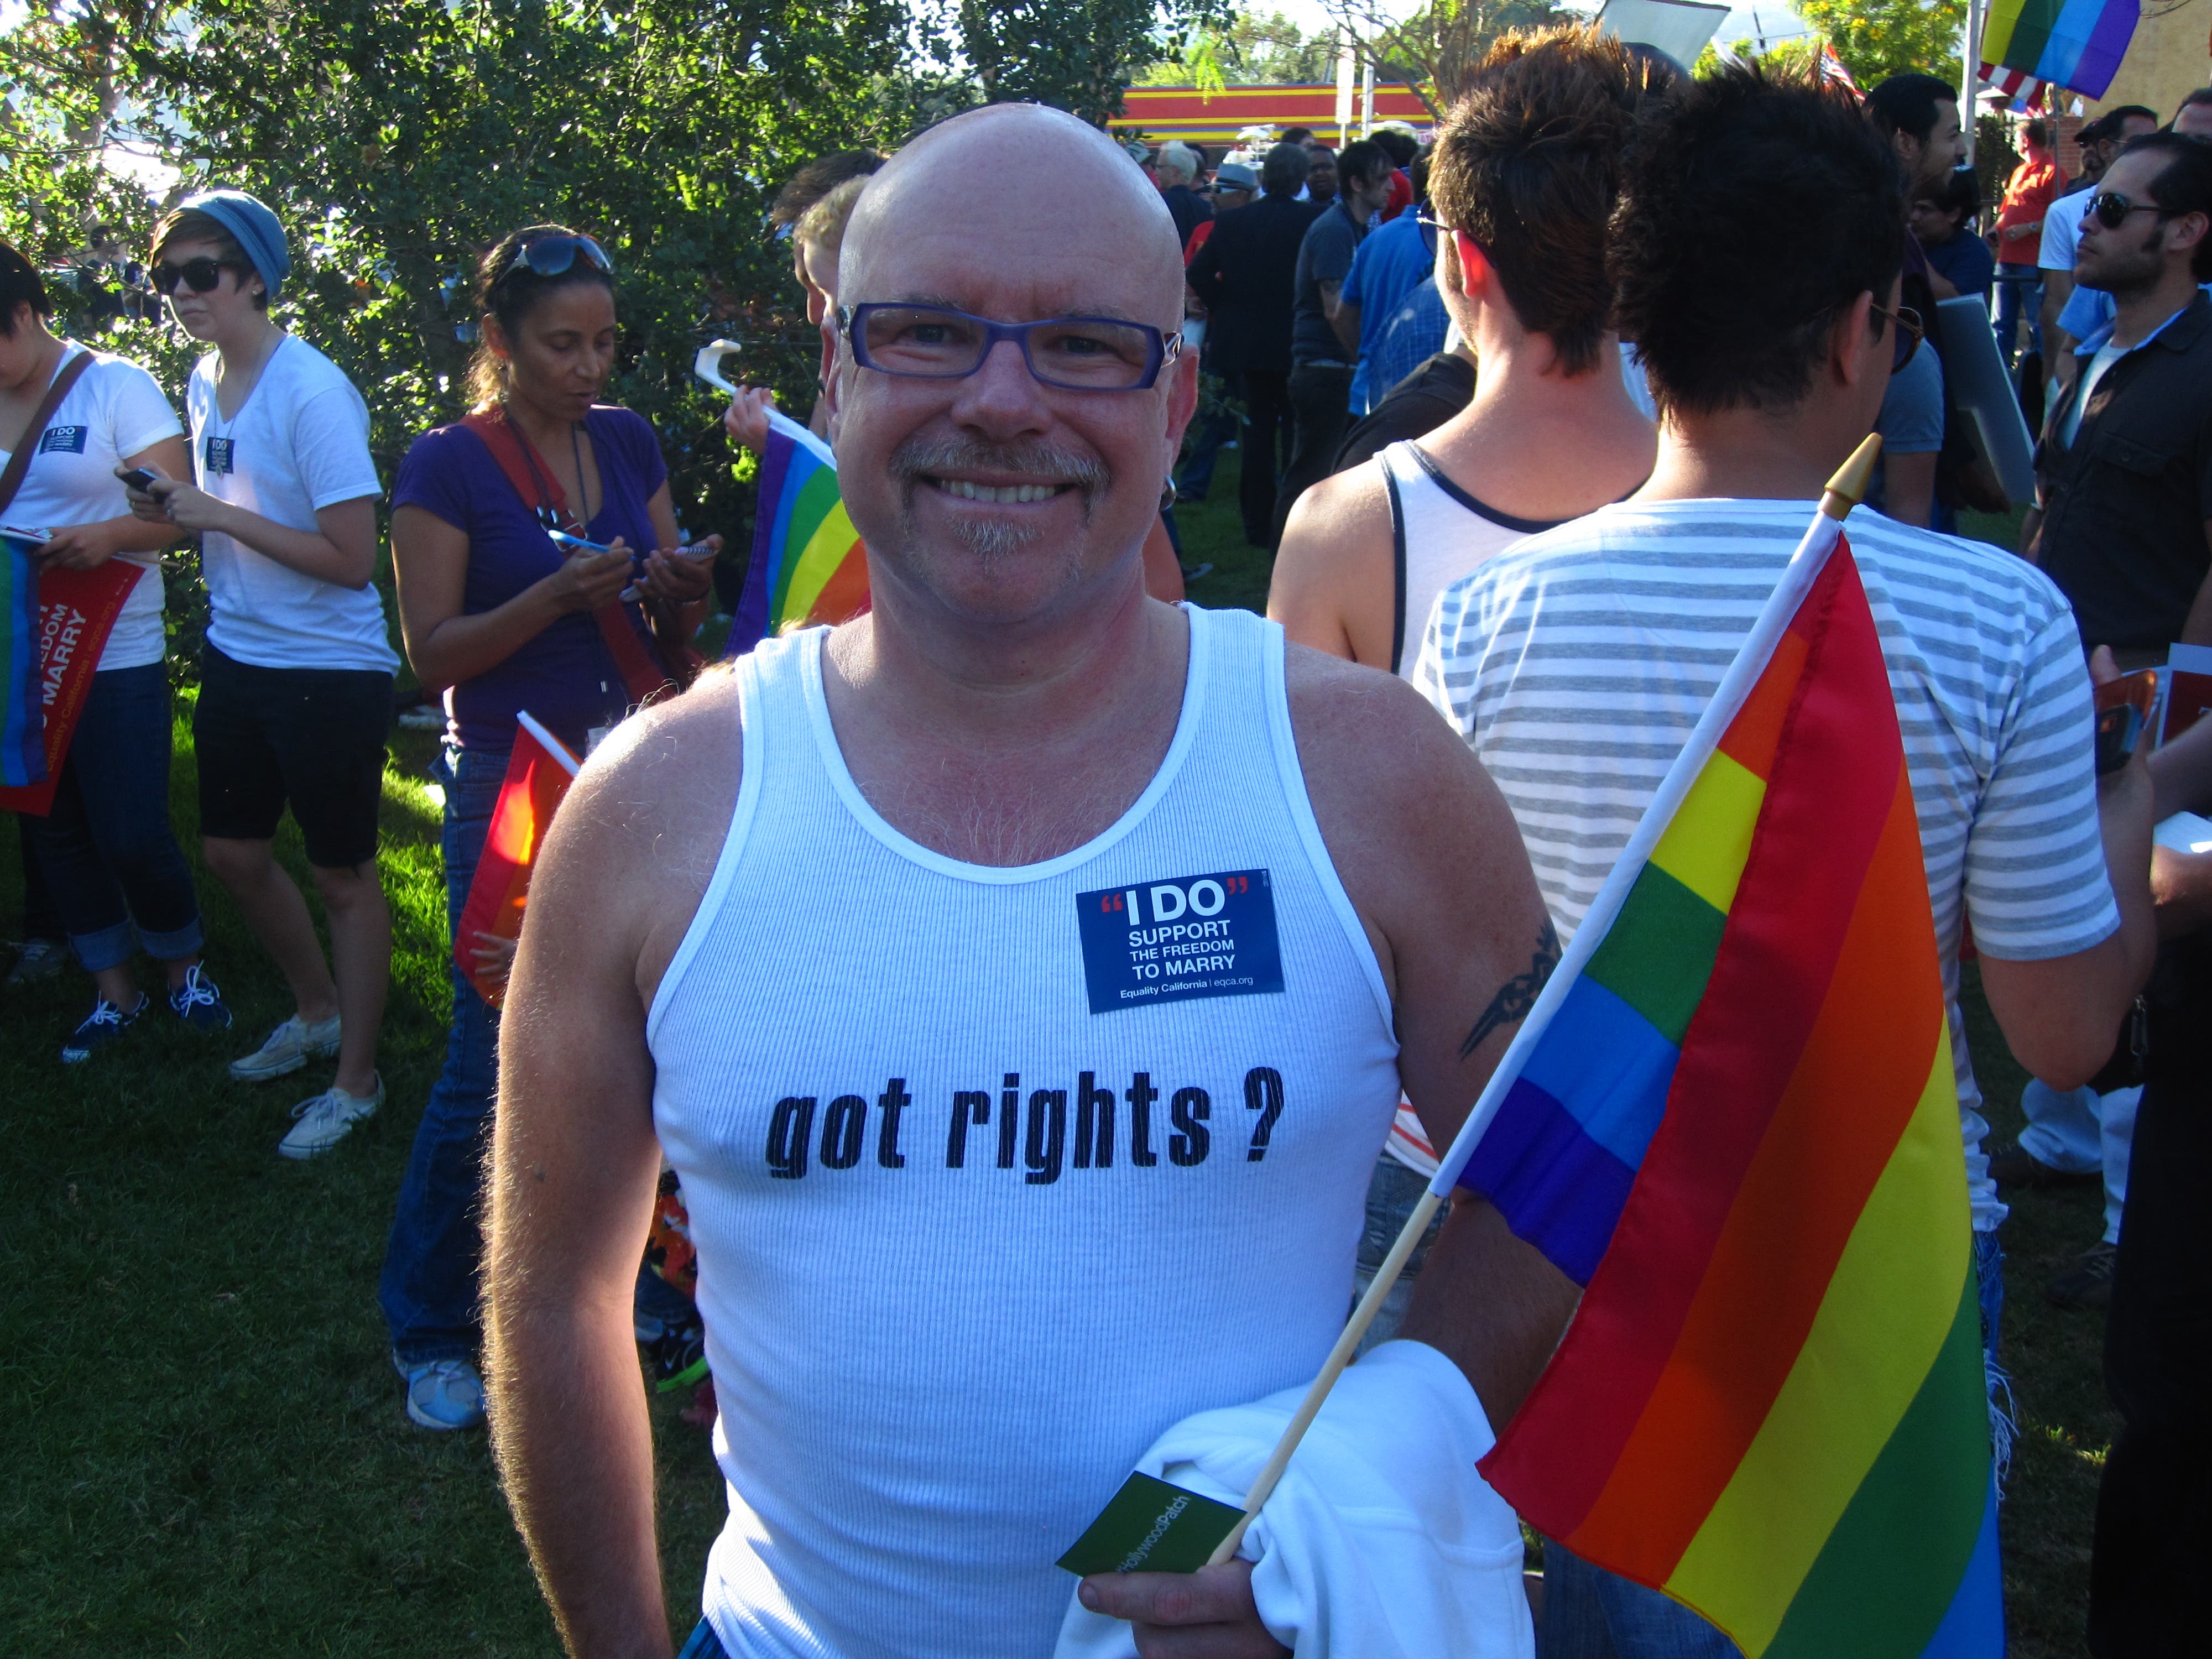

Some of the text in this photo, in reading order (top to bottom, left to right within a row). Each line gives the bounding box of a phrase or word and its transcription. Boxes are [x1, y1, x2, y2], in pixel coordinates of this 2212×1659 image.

[43, 609, 87, 705] MARRY
[62, 660, 90, 718] California
[88, 601, 116, 651] eqca.org
[1129, 920, 1230, 947] SUPPORT
[1130, 940, 1234, 962] THE FREEDOM
[1132, 954, 1235, 980] TO MARRY
[1120, 977, 1253, 999] Equality California eqca.org
[765, 1078, 912, 1180] got
[946, 1071, 1211, 1185] rights
